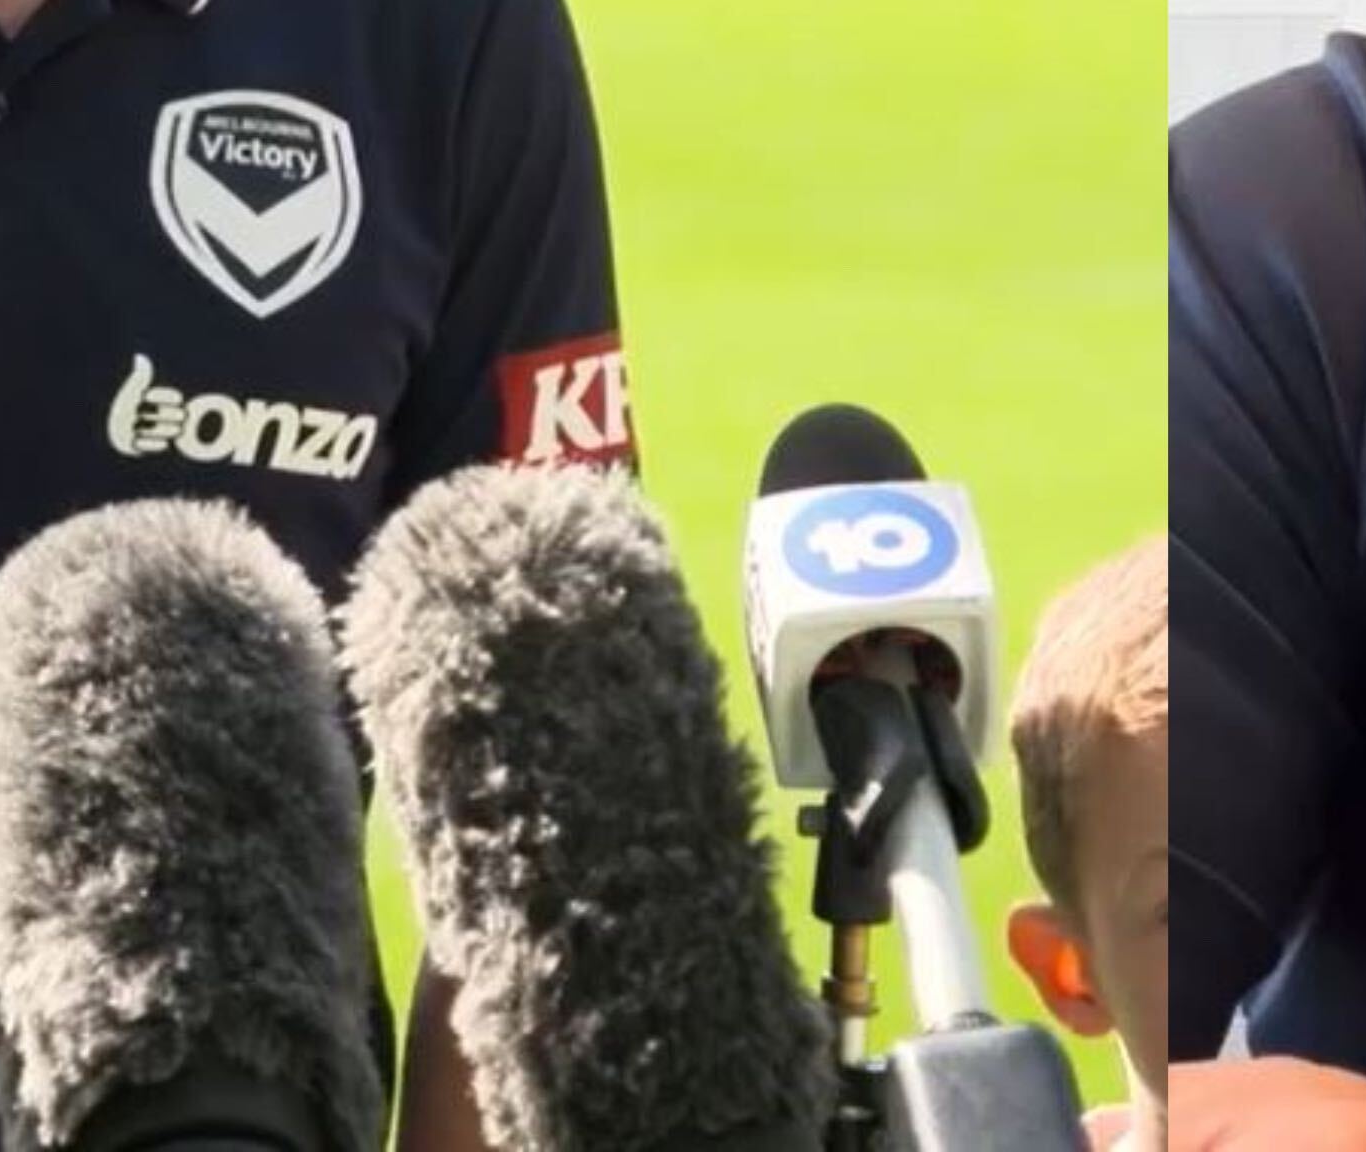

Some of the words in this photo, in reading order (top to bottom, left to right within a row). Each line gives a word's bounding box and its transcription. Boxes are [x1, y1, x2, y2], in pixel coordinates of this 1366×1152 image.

[198, 131, 318, 181] Victory
[107, 352, 378, 479] bonza
[805, 512, 932, 574] 10
